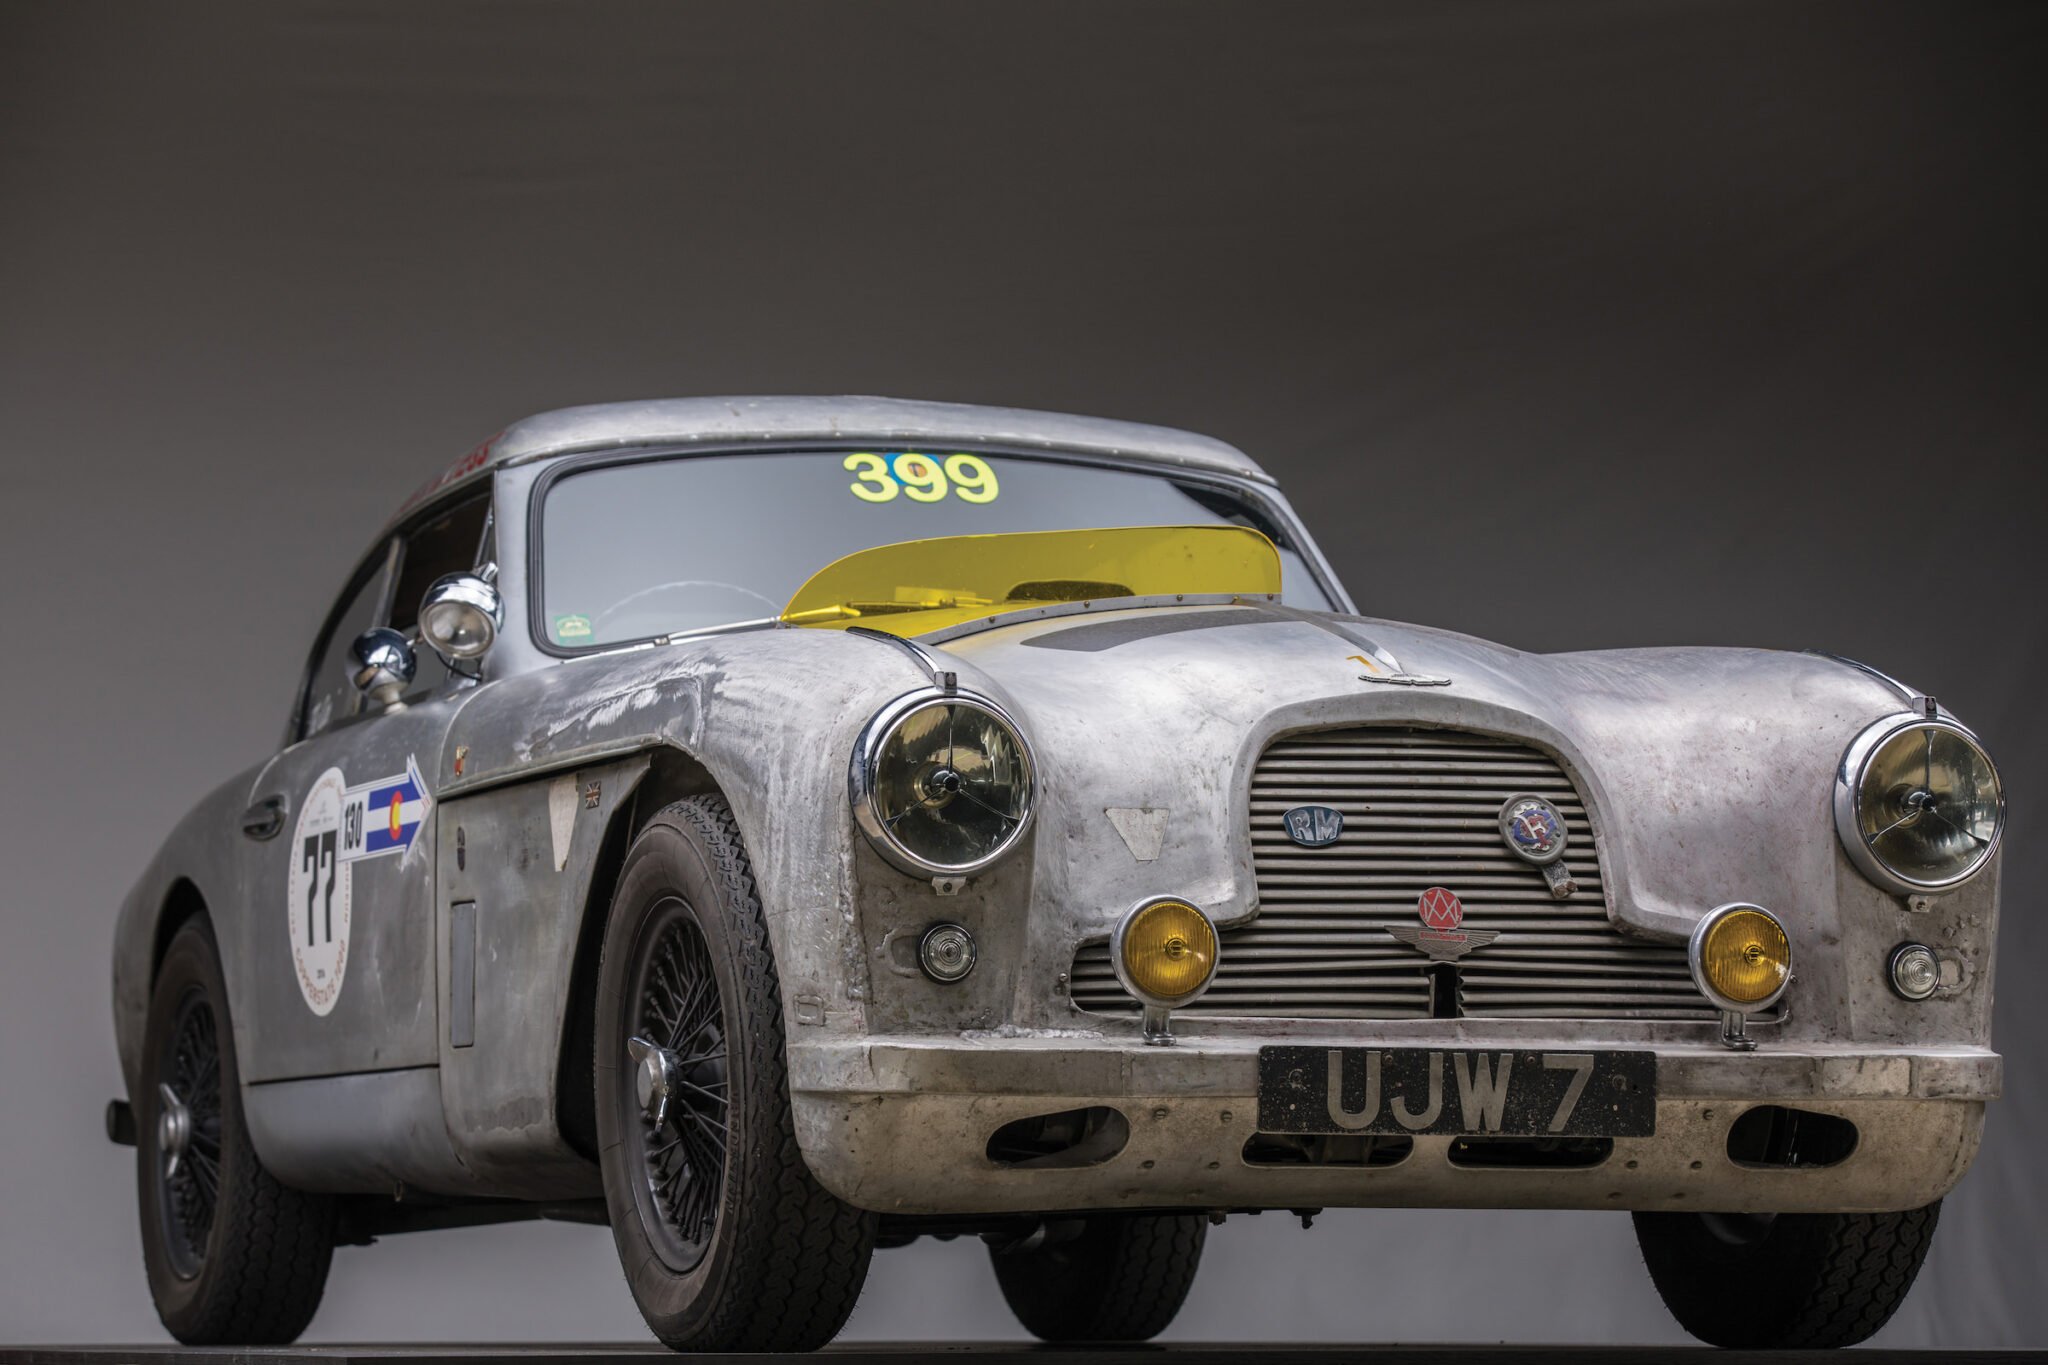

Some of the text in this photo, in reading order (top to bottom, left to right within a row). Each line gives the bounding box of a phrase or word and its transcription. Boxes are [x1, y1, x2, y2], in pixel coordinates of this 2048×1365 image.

[843, 453, 999, 503] 399
[344, 800, 363, 851] 130
[303, 829, 338, 947] 77
[1327, 1050, 1595, 1133] UJW 7
